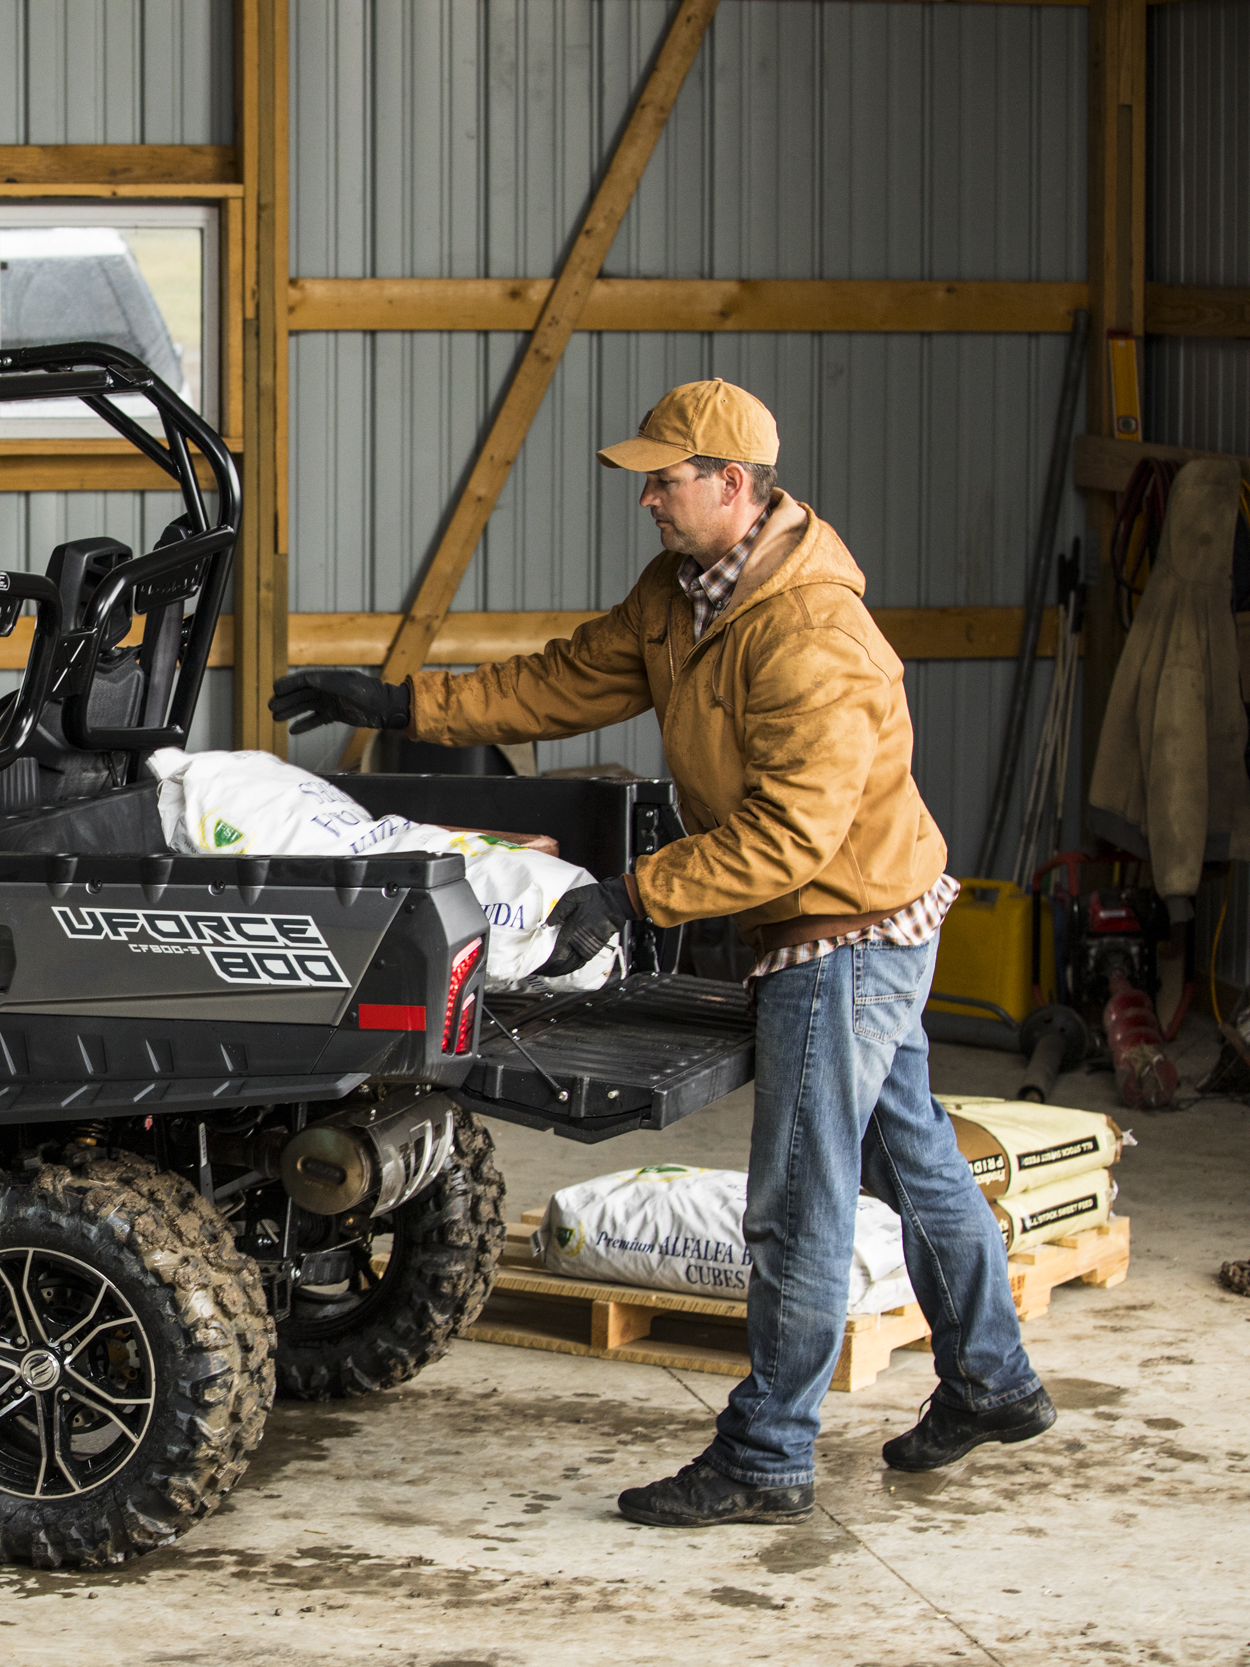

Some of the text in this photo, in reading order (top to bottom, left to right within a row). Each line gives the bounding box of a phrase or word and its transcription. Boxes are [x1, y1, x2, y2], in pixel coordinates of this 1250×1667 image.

[216, 822, 238, 841] FSI
[51, 906, 329, 948] UFORCE
[128, 943, 200, 955] CF800-3
[202, 945, 352, 988] 800
[596, 1231, 655, 1254] Premium
[658, 1236, 734, 1264] ALFALFA
[685, 1264, 746, 1290] CUBES
